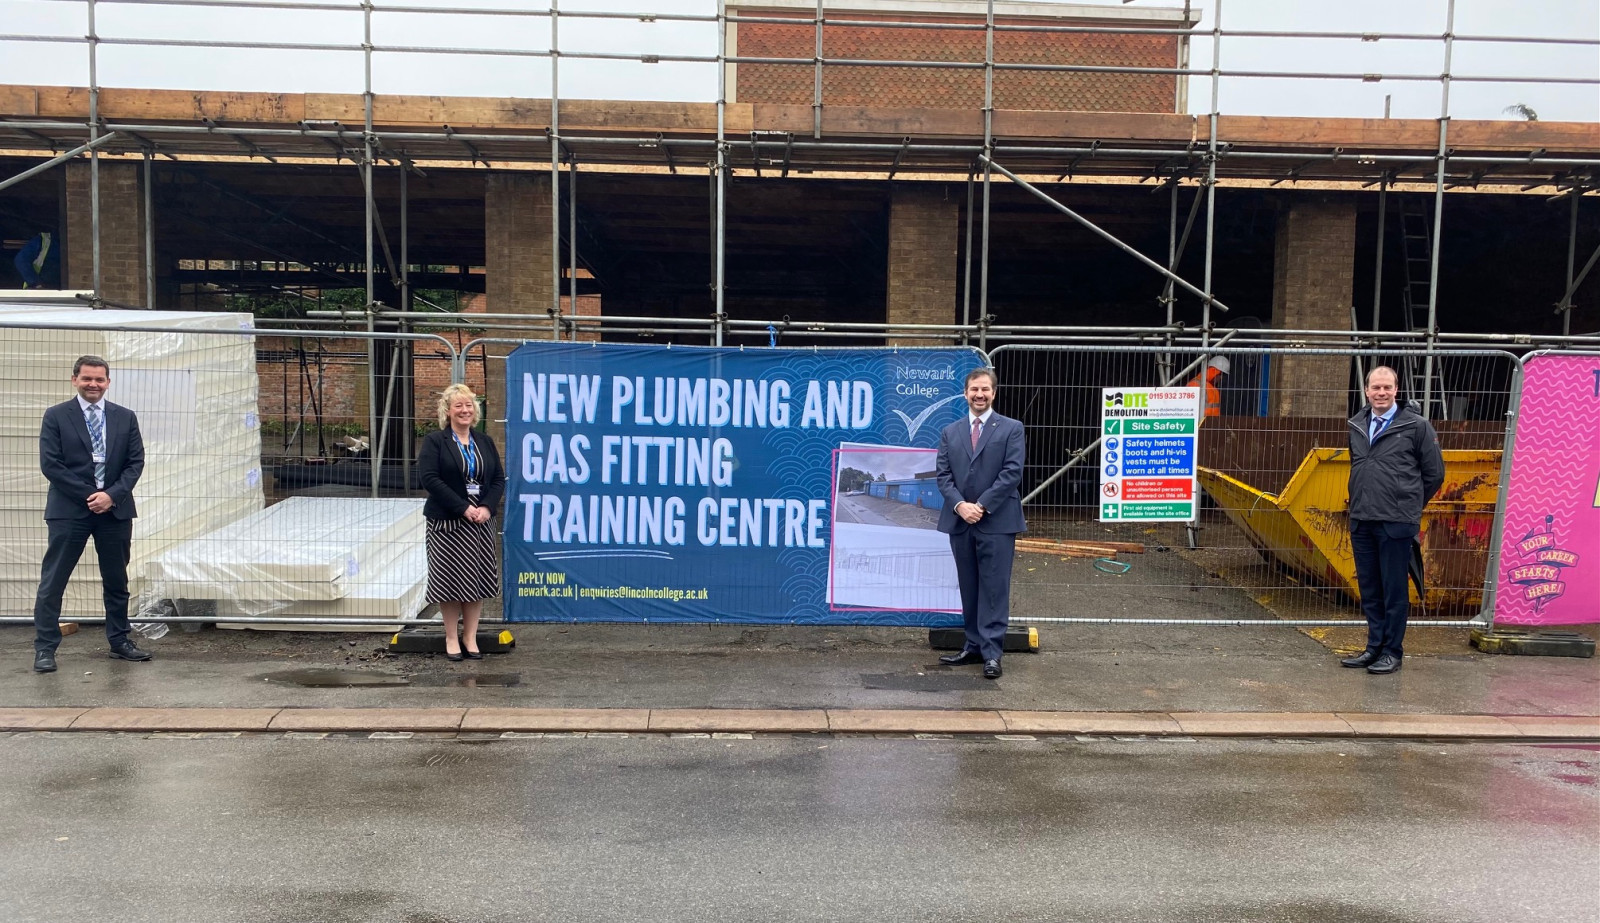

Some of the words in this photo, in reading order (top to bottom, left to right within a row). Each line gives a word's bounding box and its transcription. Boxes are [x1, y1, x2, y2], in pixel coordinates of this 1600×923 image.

[896, 365, 955, 380] Newark
[896, 384, 939, 398] College
[522, 372, 601, 424] NEW
[612, 375, 791, 428] PLUMBING
[800, 380, 874, 430] AND
[1124, 393, 1148, 408] DTE
[1105, 408, 1148, 417] DEMOLITION
[1132, 422, 1150, 430] Site
[1153, 422, 1186, 431] Safety
[1126, 440, 1152, 448] Safety
[522, 432, 592, 484] GAS
[602, 435, 734, 488] FITTING
[520, 494, 686, 546] TRAINING
[697, 497, 827, 548] CENTRE
[1522, 536, 1548, 551] YOUR
[1540, 551, 1575, 564] CAREER
[518, 572, 544, 584] APPLY
[546, 573, 566, 585] NOW
[1514, 568, 1556, 579] STARTS
[518, 585, 573, 597] newark.ac.uk
[580, 586, 709, 602] enquiries@lincolncollege.ac.uk
[1528, 584, 1562, 598] HERE!
